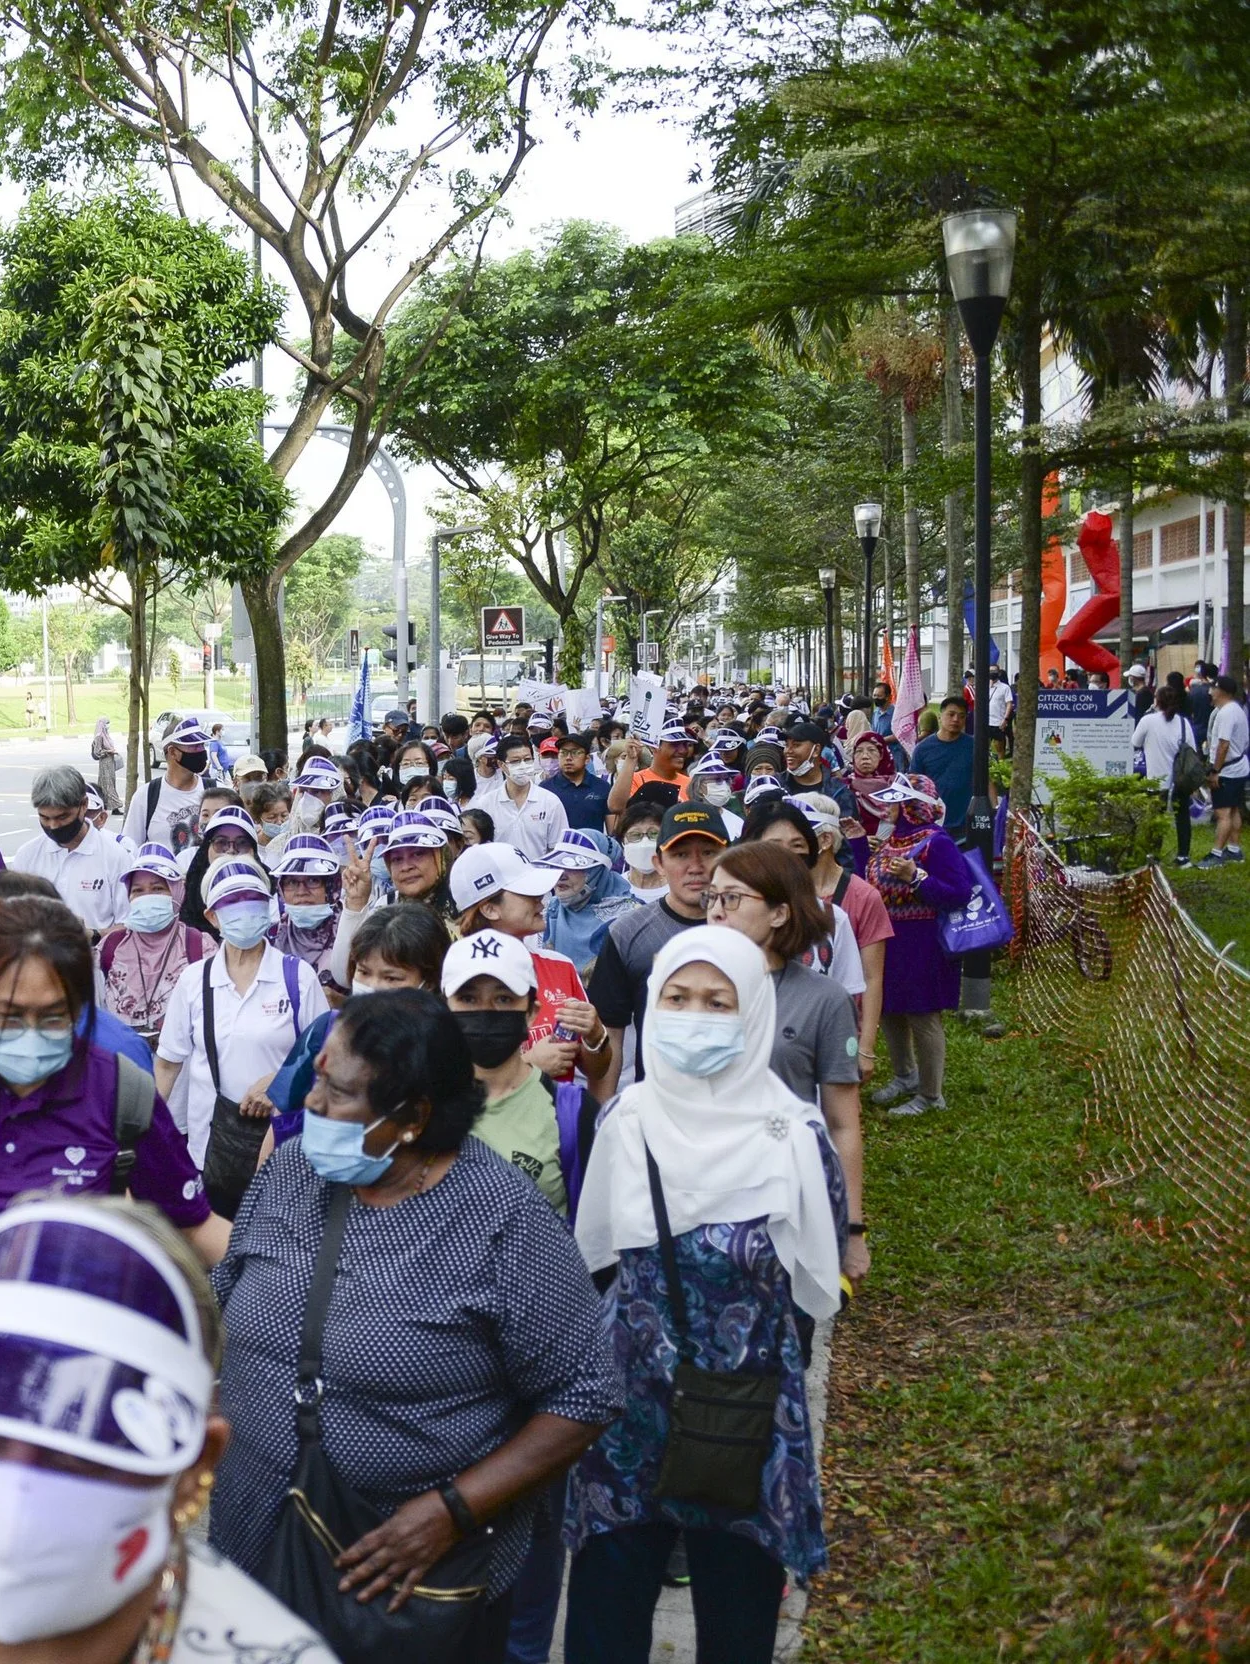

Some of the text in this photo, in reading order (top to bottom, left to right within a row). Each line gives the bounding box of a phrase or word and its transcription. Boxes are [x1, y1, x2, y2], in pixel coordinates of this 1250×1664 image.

[1038, 694, 1093, 702] CITIZENS ON
[1038, 703, 1098, 712] PATROL (COP)
[470, 936, 503, 959] NY
